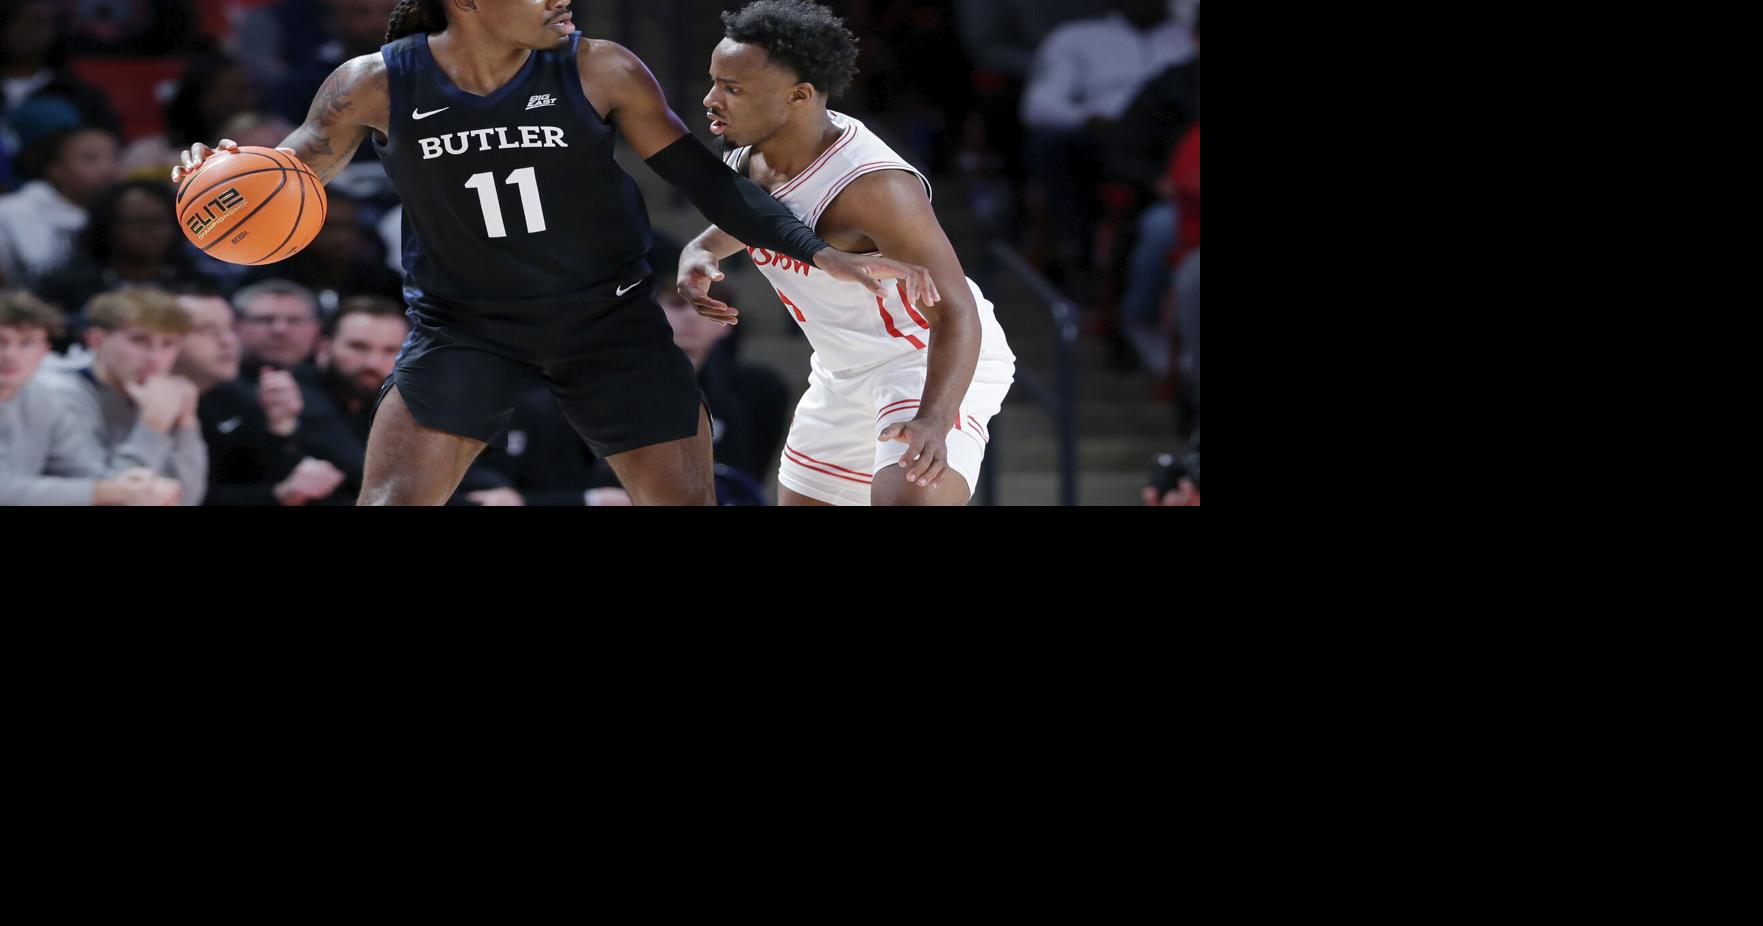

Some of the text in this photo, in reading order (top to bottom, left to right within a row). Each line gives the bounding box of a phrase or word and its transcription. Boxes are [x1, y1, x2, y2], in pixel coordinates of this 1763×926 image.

[527, 98, 558, 107] EAST
[529, 93, 551, 102] BIG
[418, 126, 569, 160] BUTLER
[464, 166, 547, 238] 11
